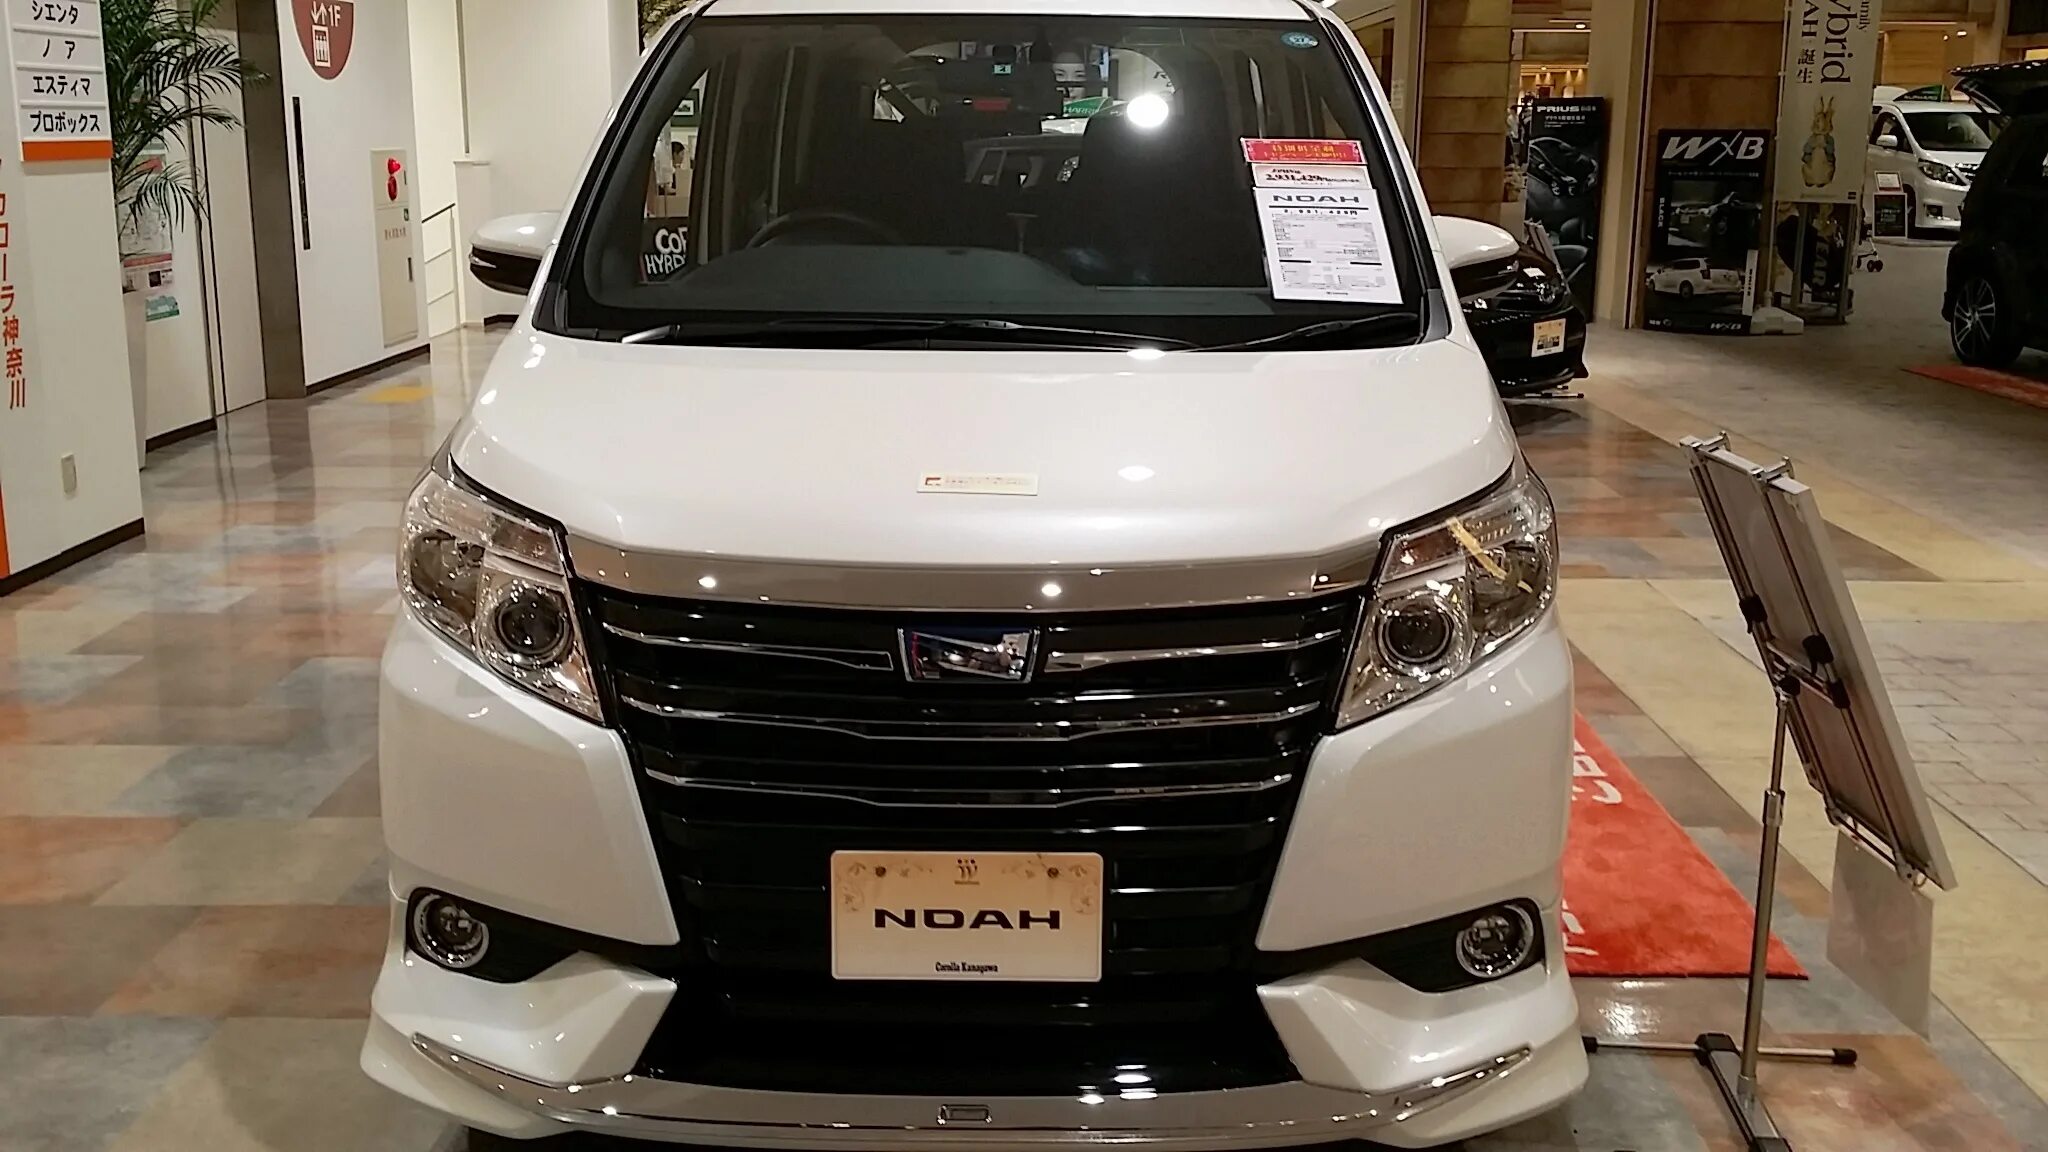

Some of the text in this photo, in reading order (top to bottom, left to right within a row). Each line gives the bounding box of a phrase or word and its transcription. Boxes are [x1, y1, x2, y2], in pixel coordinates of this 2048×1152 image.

[31, 1, 79, 25] シエンタ
[328, 4, 341, 27] 1F
[1796, 48, 1816, 84] 誕生
[33, 75, 91, 97] エスティマ
[1536, 105, 1580, 113] PRIUS
[30, 110, 100, 133] プロボックス
[1272, 195, 1360, 203] NOAH
[874, 908, 1060, 930] NOAH
[935, 961, 998, 974] Corolla Kanagawa
